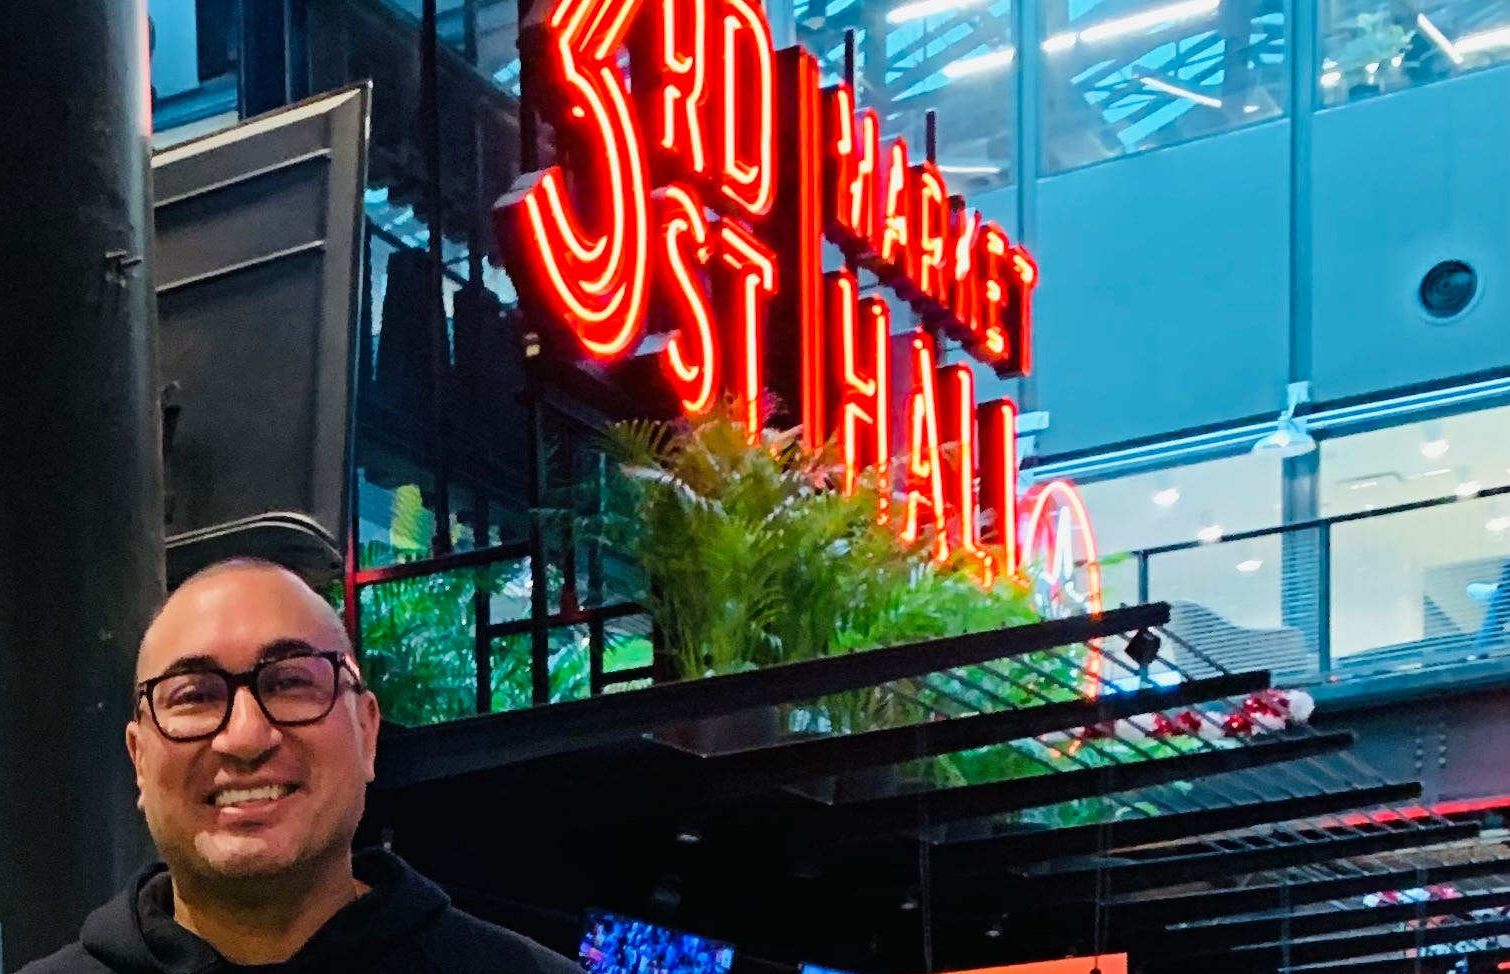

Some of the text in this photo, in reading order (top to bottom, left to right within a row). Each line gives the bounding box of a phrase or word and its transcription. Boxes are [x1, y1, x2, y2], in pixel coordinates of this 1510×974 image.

[658, 184, 778, 445] ST
[832, 82, 1039, 377] MARKET
[830, 264, 1030, 590] HALL
